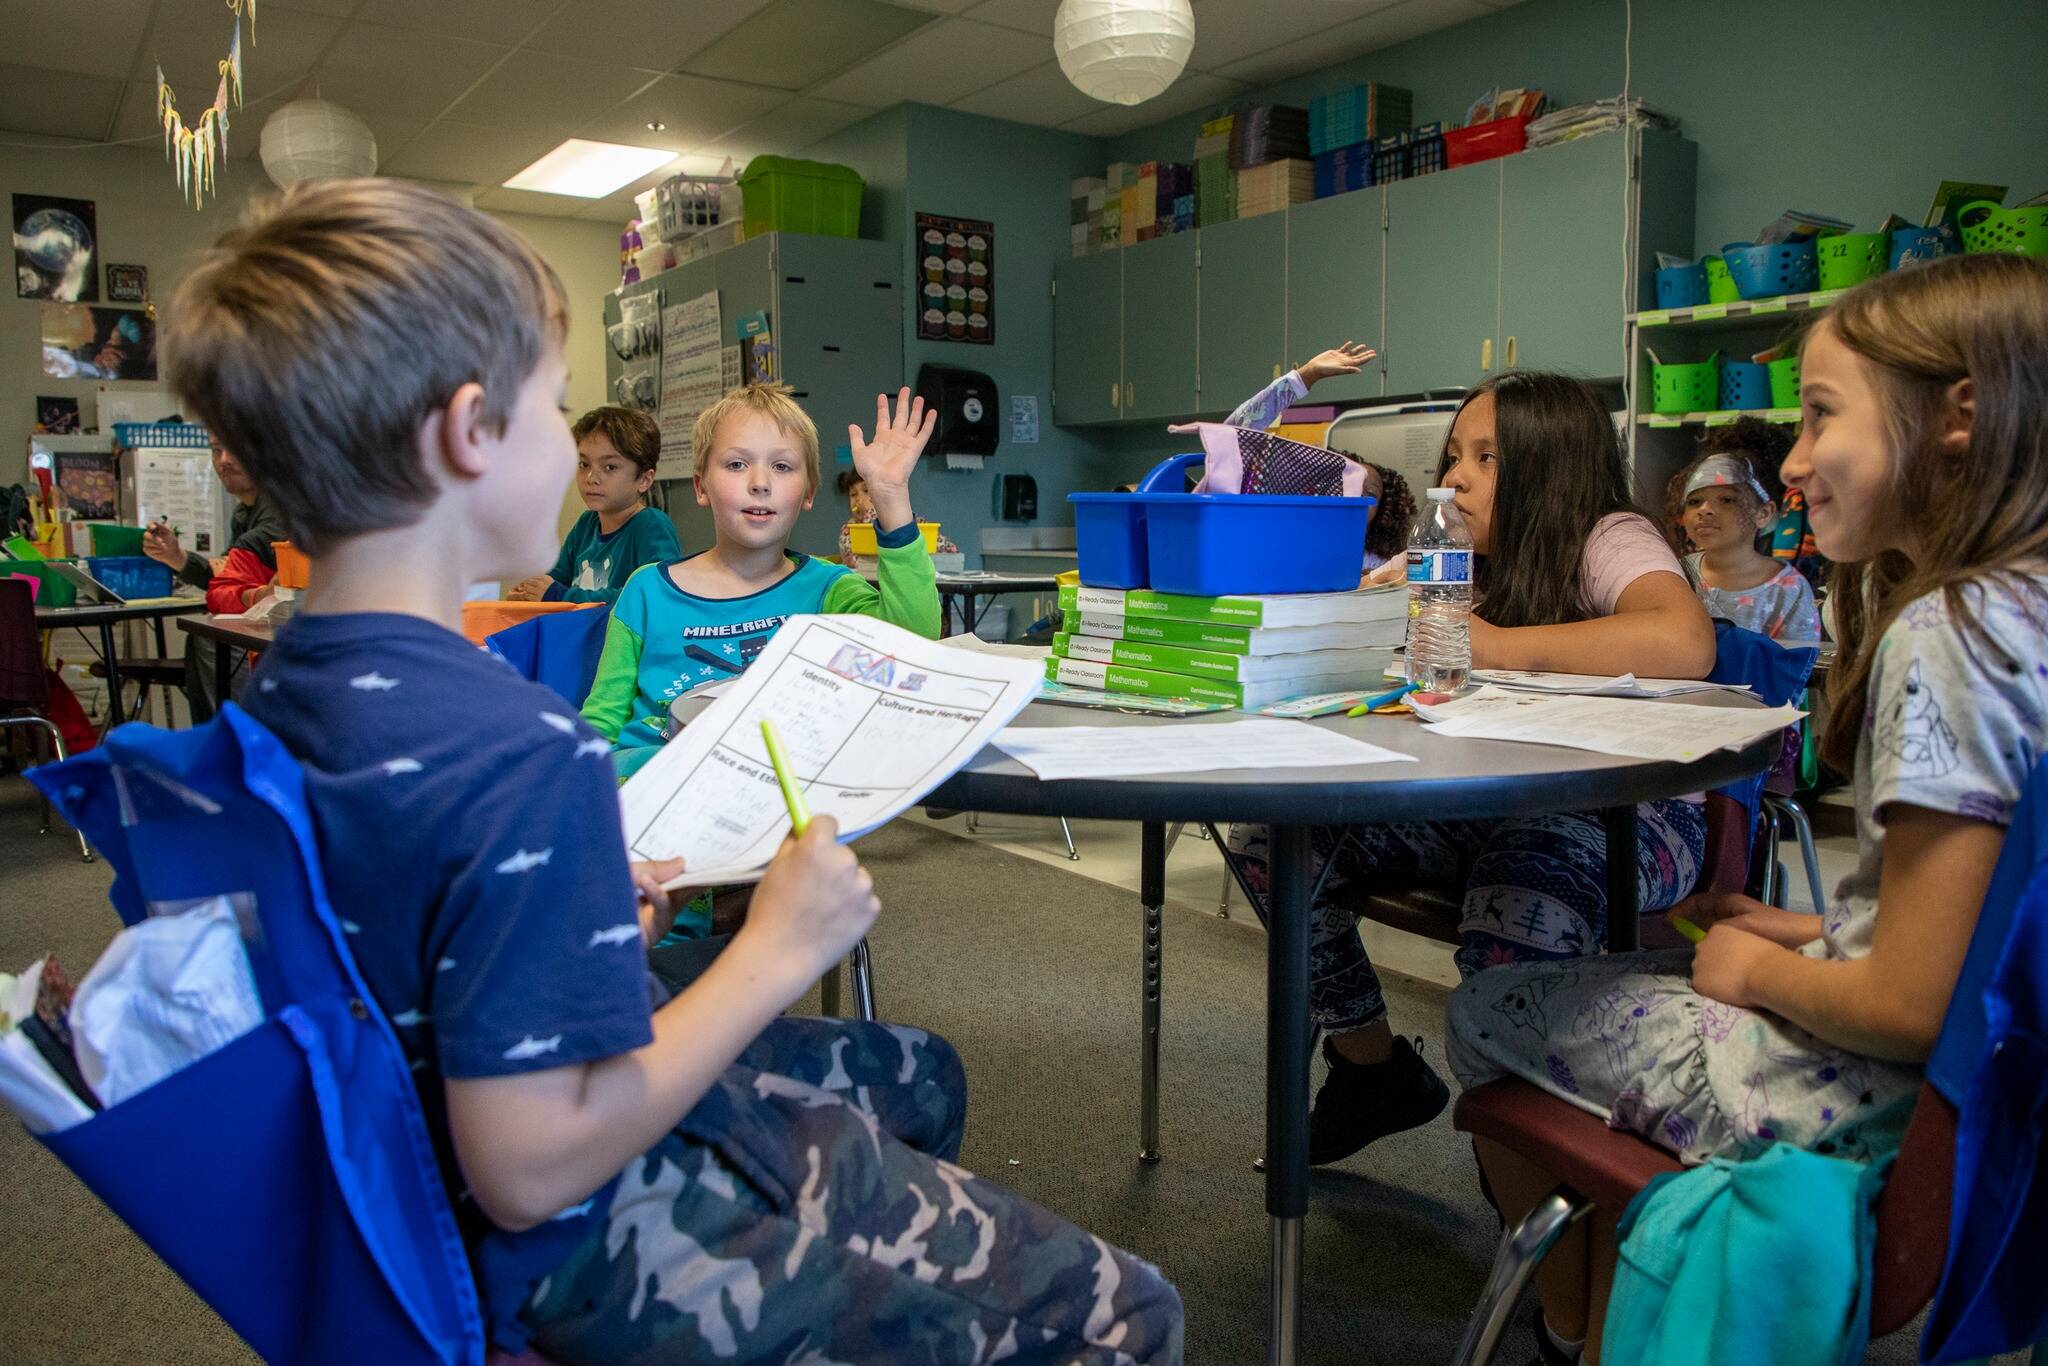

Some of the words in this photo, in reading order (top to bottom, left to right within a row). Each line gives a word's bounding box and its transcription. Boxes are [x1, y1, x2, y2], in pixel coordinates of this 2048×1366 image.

[1833, 244, 1848, 257] 22
[1129, 600, 1168, 611] Mathematics
[683, 615, 787, 638] MINECRAFT
[1127, 625, 1163, 637] Mathematics
[1090, 645, 1111, 653] Classroom
[1116, 649, 1153, 662] Mathematics
[801, 669, 842, 692] Identity
[1080, 670, 1104, 679] Classroom
[1110, 674, 1149, 687] Mathematics
[878, 697, 914, 713] Culture
[916, 707, 935, 717] and
[711, 749, 736, 768] Race
[737, 764, 759, 778] and
